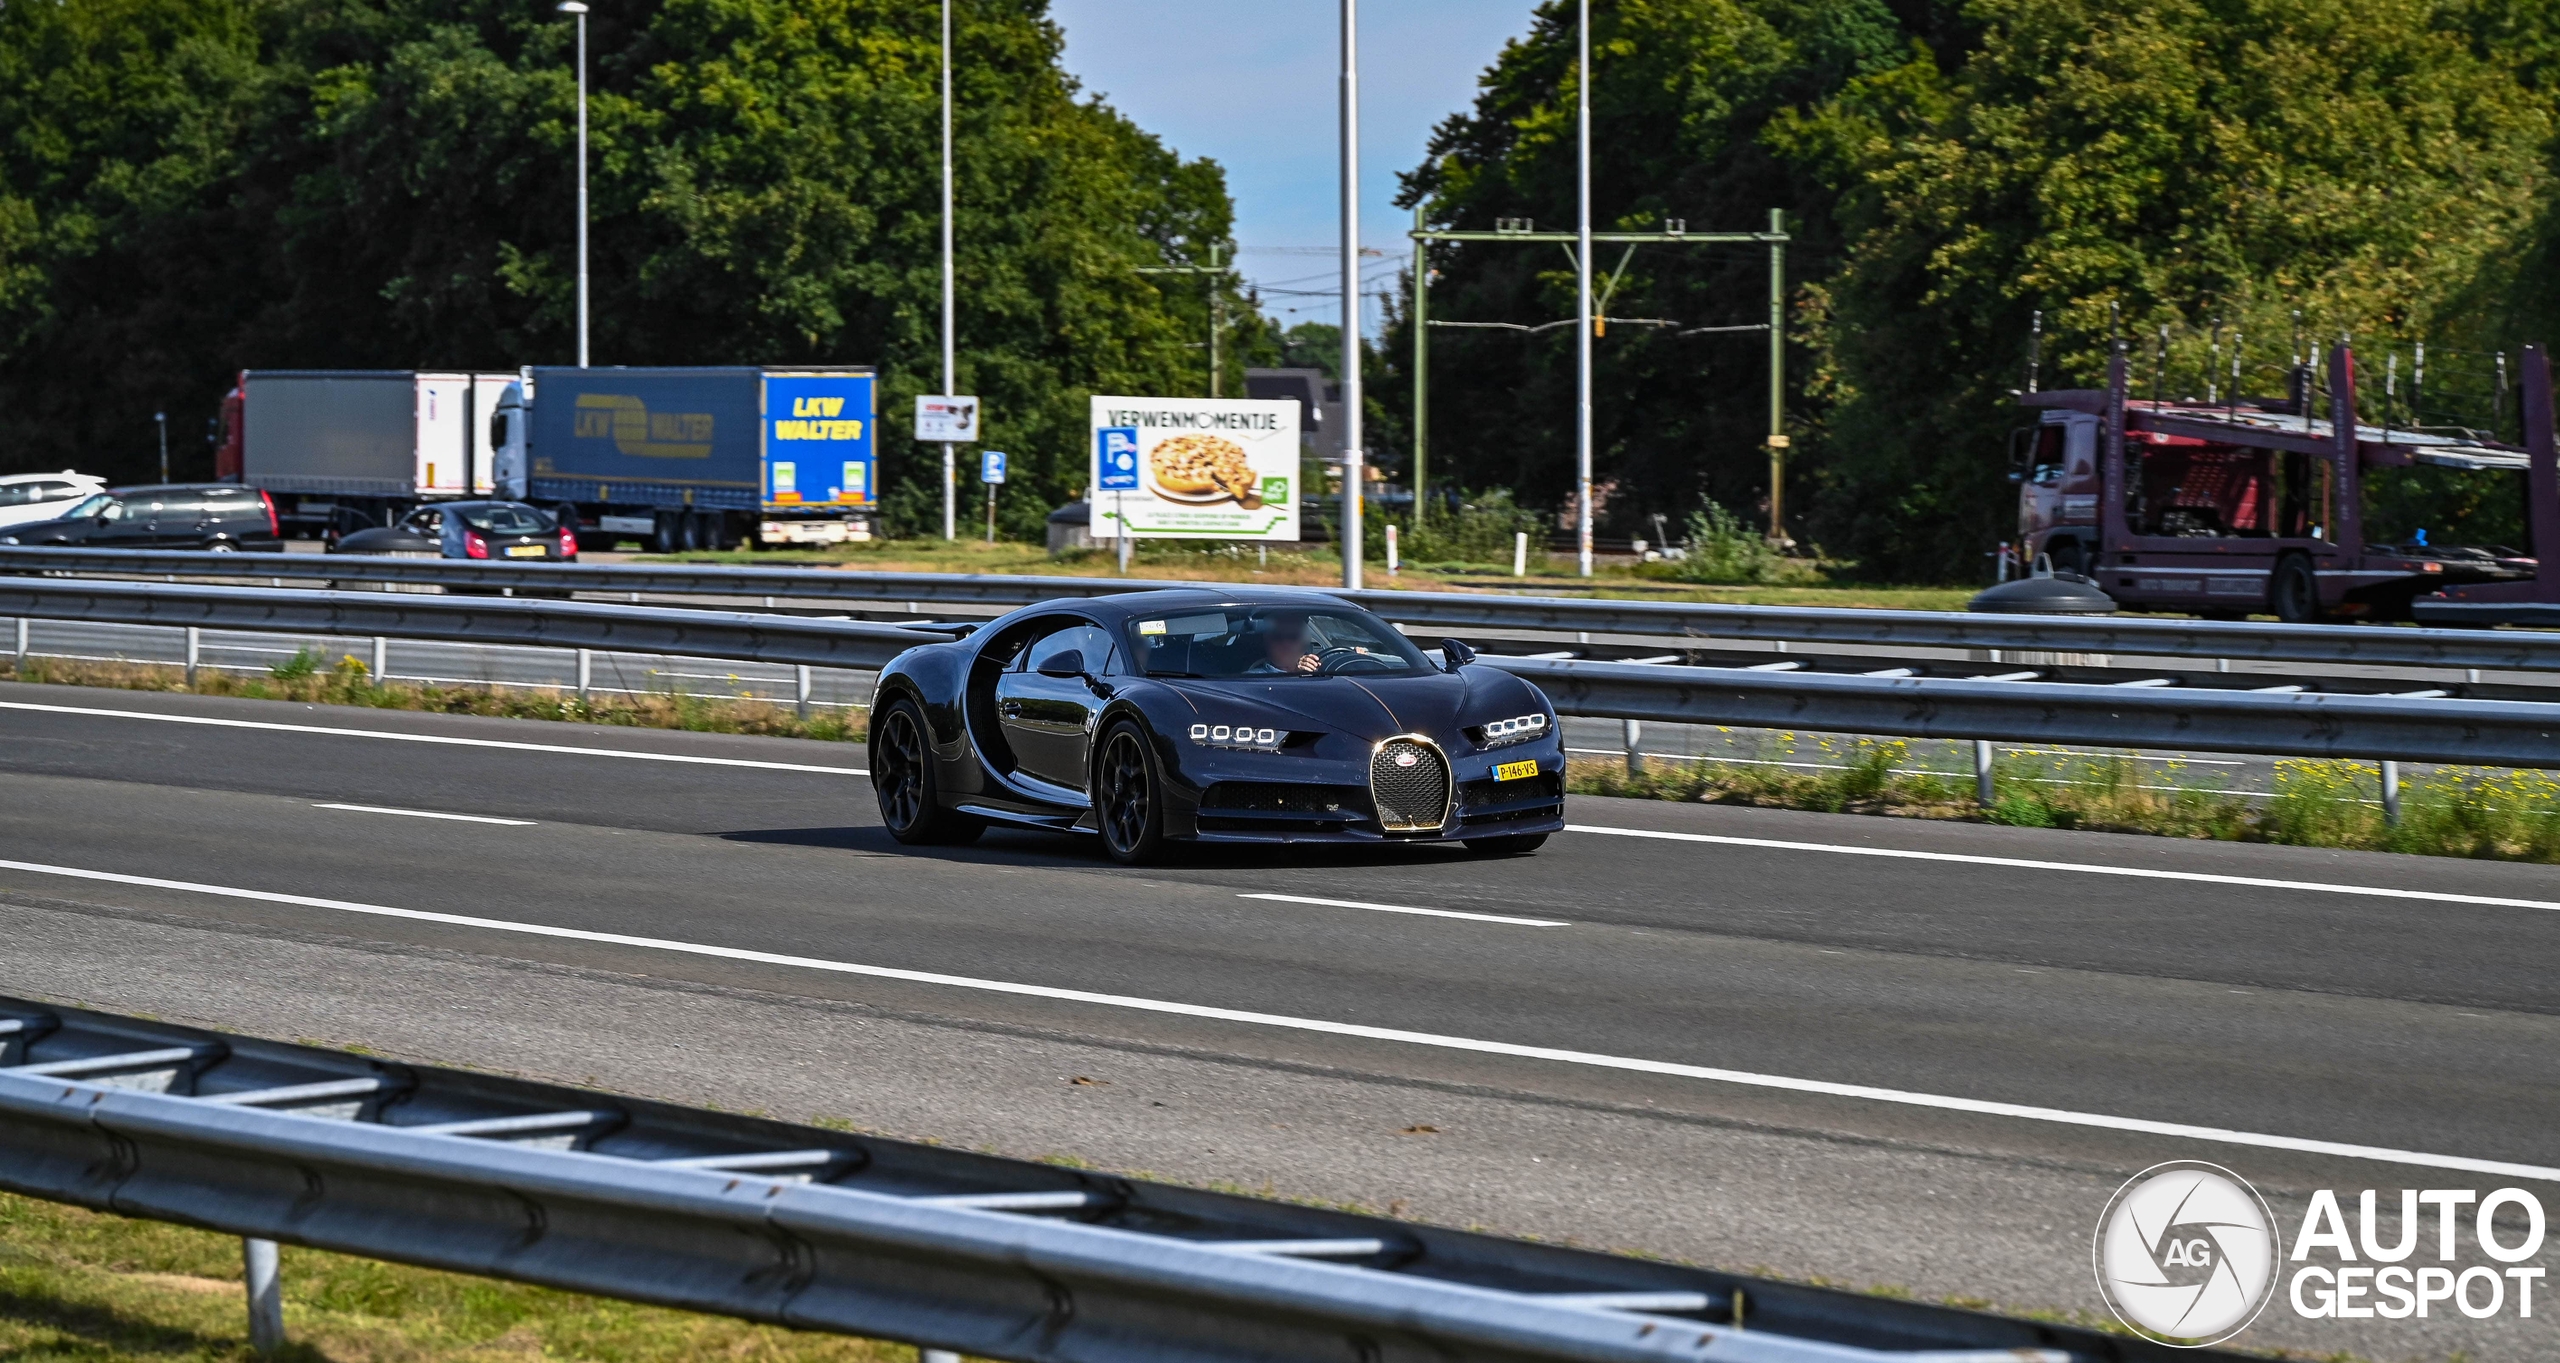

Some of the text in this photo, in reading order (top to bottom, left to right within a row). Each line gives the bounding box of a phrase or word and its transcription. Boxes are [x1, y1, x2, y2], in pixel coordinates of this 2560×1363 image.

[792, 397, 845, 417] LKW
[651, 413, 714, 441] WALTER
[1107, 409, 1277, 430] VERWENMOMENTJE
[775, 420, 863, 440] WALTER
[1500, 762, 1536, 779] P-146-VS
